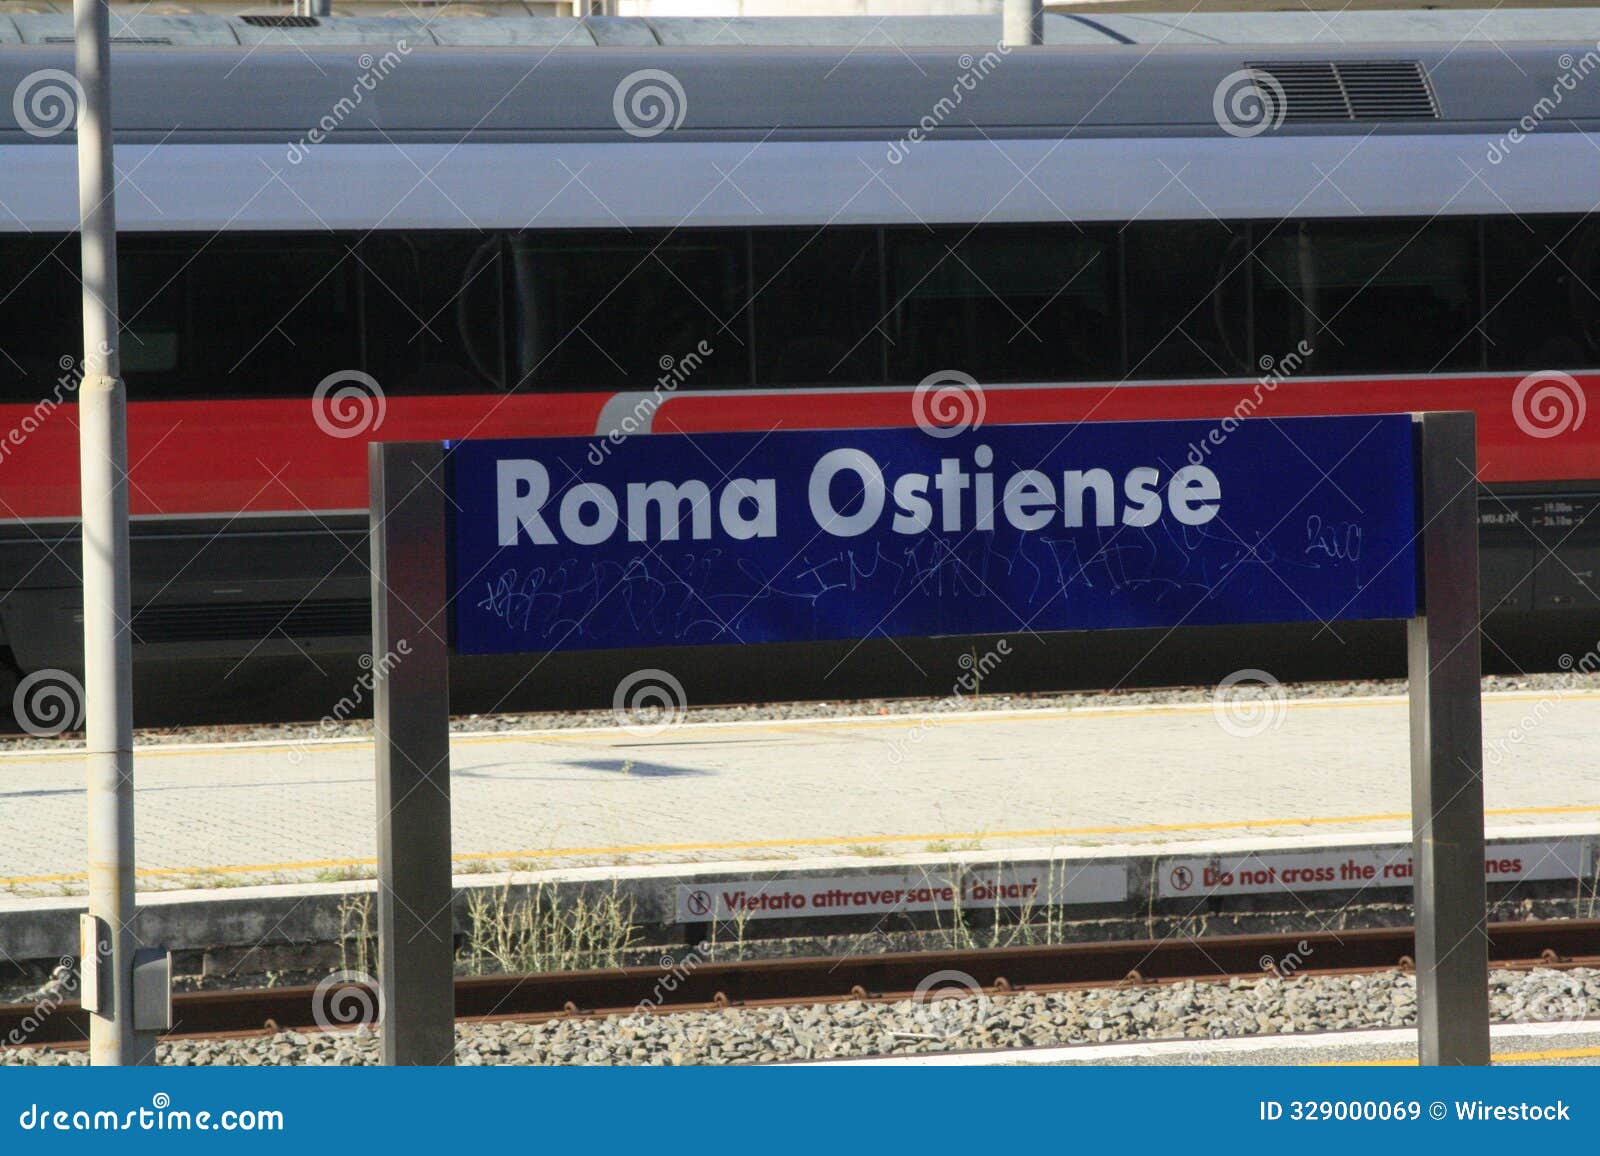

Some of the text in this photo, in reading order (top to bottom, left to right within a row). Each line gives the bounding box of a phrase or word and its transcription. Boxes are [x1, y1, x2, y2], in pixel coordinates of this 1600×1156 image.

[496, 444, 1222, 546] Roma Ostiense
[1203, 866, 1235, 887] Do
[1240, 866, 1277, 885] not
[1281, 866, 1336, 884] cross
[1340, 859, 1376, 880] the
[1485, 857, 1522, 874] nes
[722, 890, 807, 911] Vietato
[812, 886, 955, 908] attraversare
[973, 877, 1038, 900] binari
